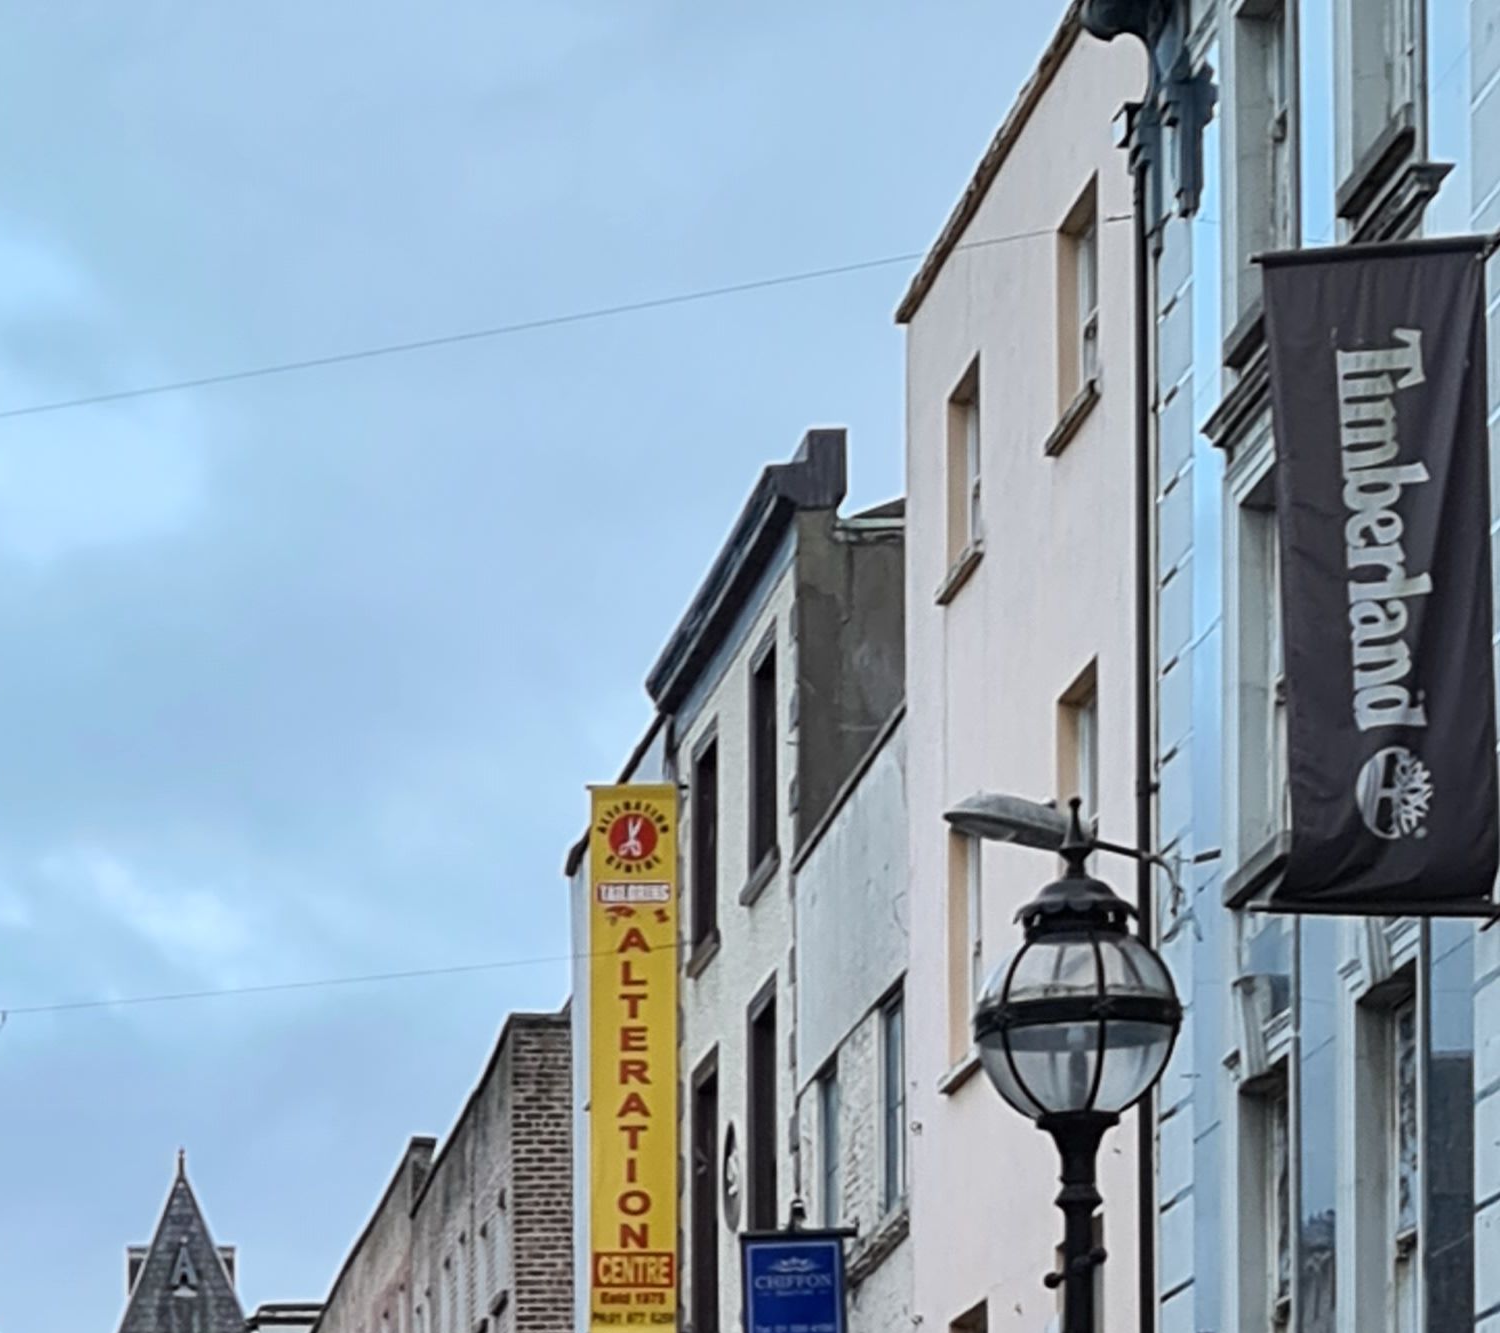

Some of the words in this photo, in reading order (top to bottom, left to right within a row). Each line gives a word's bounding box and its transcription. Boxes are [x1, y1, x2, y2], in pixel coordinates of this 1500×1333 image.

[1336, 328, 1434, 731] Timberland
[616, 927, 653, 1249] ALTERATION
[598, 1256, 671, 1284] CENTRE
